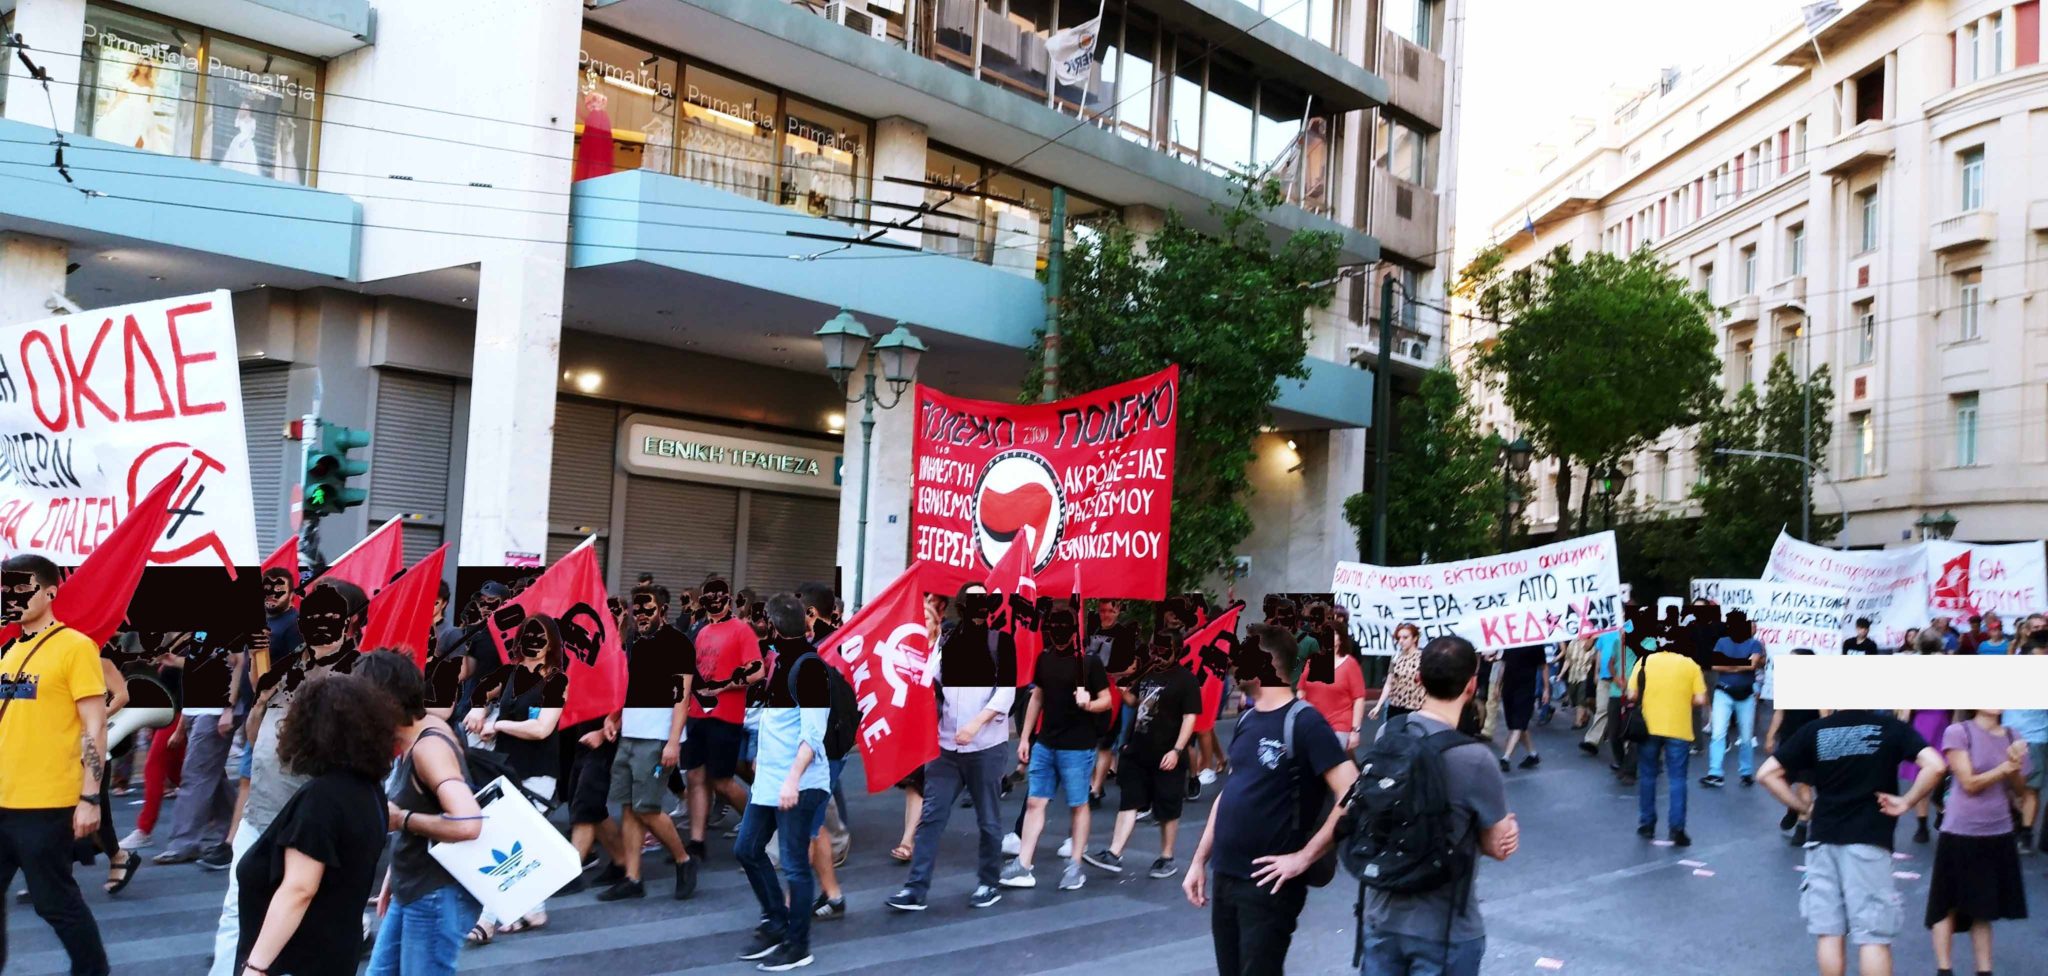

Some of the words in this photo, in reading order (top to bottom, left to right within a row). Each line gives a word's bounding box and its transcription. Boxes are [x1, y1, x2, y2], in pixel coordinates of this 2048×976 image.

[207, 55, 316, 102] Primalicia
[579, 50, 673, 98] Primalicia
[687, 84, 774, 130] Primalicia
[788, 116, 866, 159] Primalicia
[20, 301, 227, 432] ΟΚΔΕ
[921, 400, 1015, 449] ΠΟΛΕΜΟ
[1054, 379, 1175, 449] ΠΟΛΕΜΟ
[643, 435, 724, 464] ΕΘΝΙΚΗ
[729, 448, 820, 476] ΤΡΑΠΕΖΑ
[1064, 447, 1167, 495] ΑΚΡΟΔΕΞΙΑΣ
[1373, 604, 1394, 619] ΤΑ
[1400, 594, 1462, 620] ΞΕΡΑ
[1518, 573, 1557, 602] ΑΠΟ
[1567, 574, 1598, 594] ΤΙΣ
